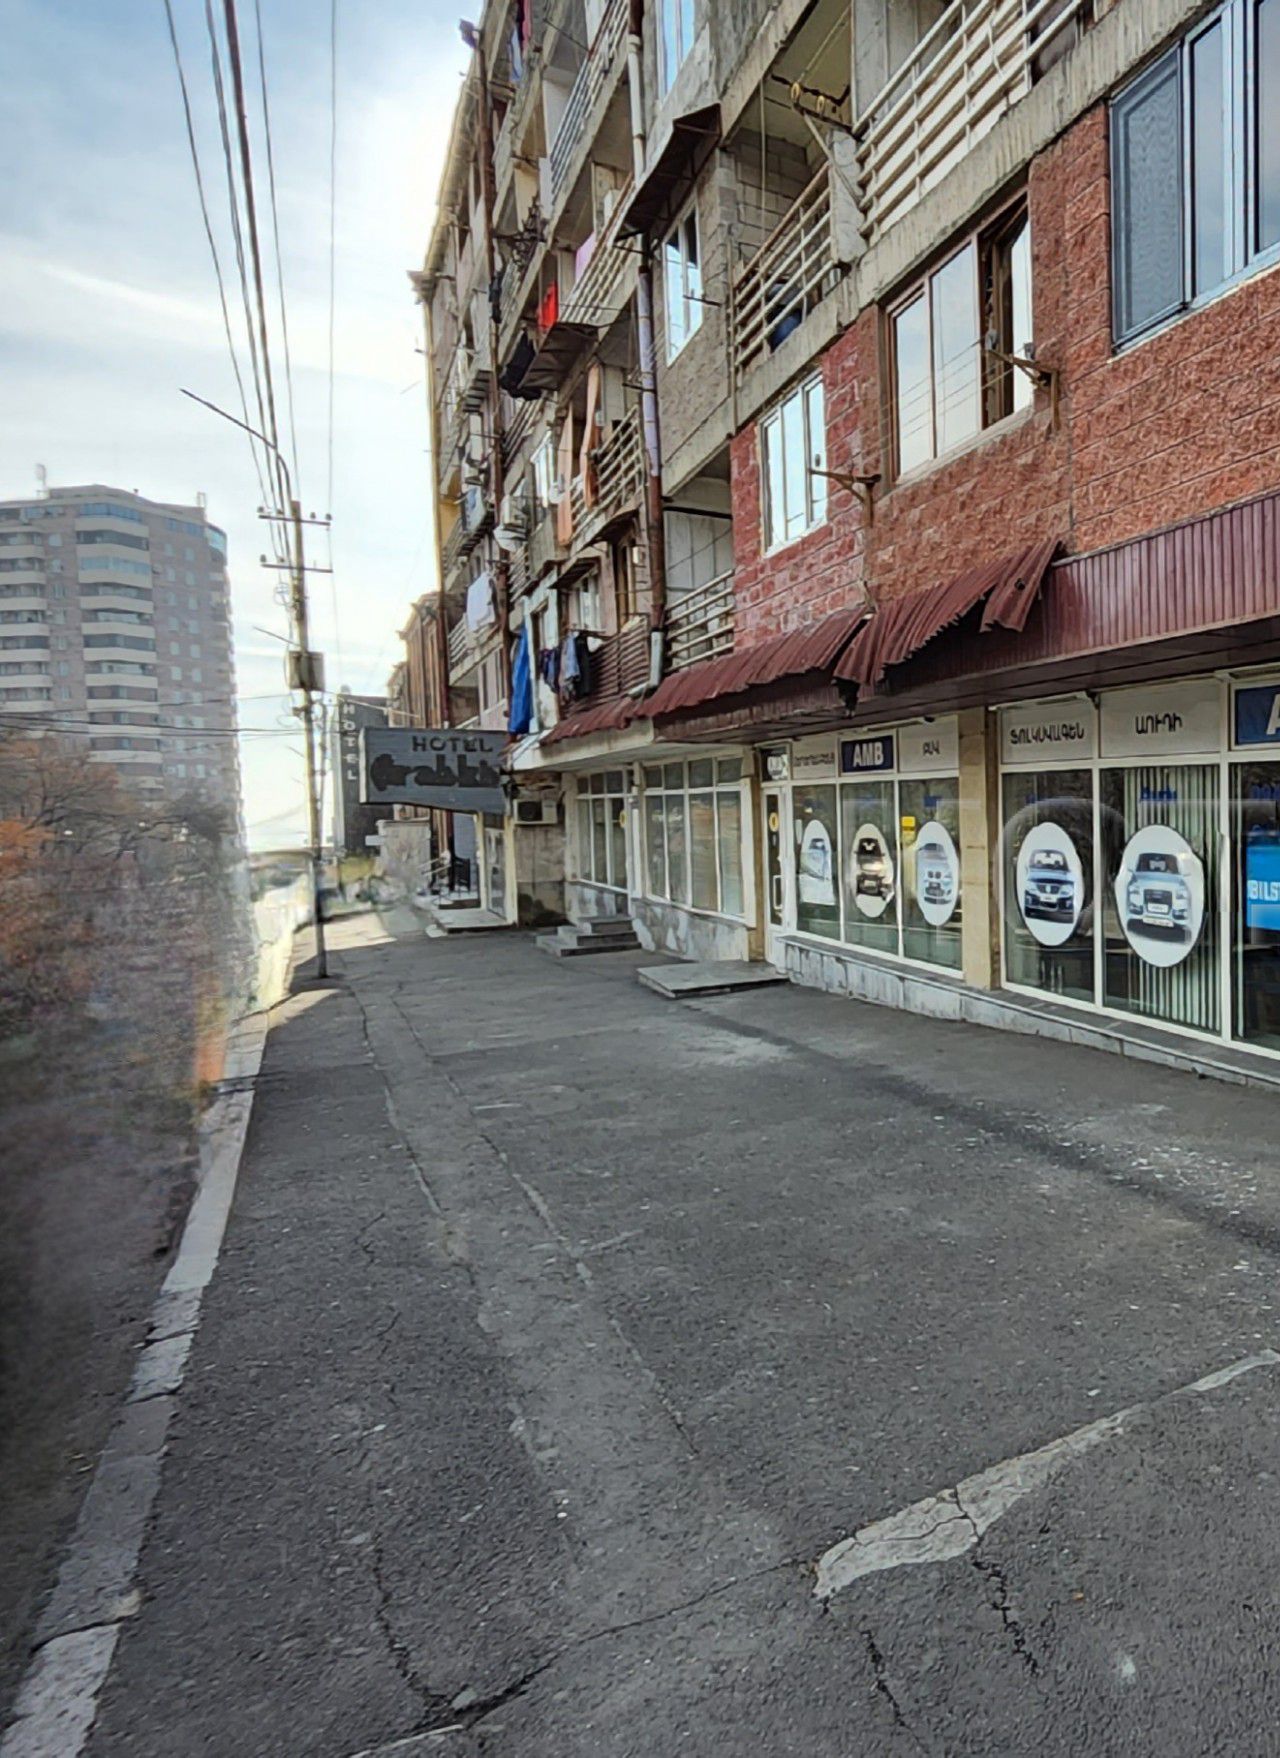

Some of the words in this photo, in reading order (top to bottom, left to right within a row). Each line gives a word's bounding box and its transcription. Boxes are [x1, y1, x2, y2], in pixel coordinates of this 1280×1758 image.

[1135, 712, 1183, 734] ԱՈՒԴԻ
[342, 703, 358, 781] HOTEL
[412, 736, 493, 753] HOTEL
[853, 741, 884, 767] AMB
